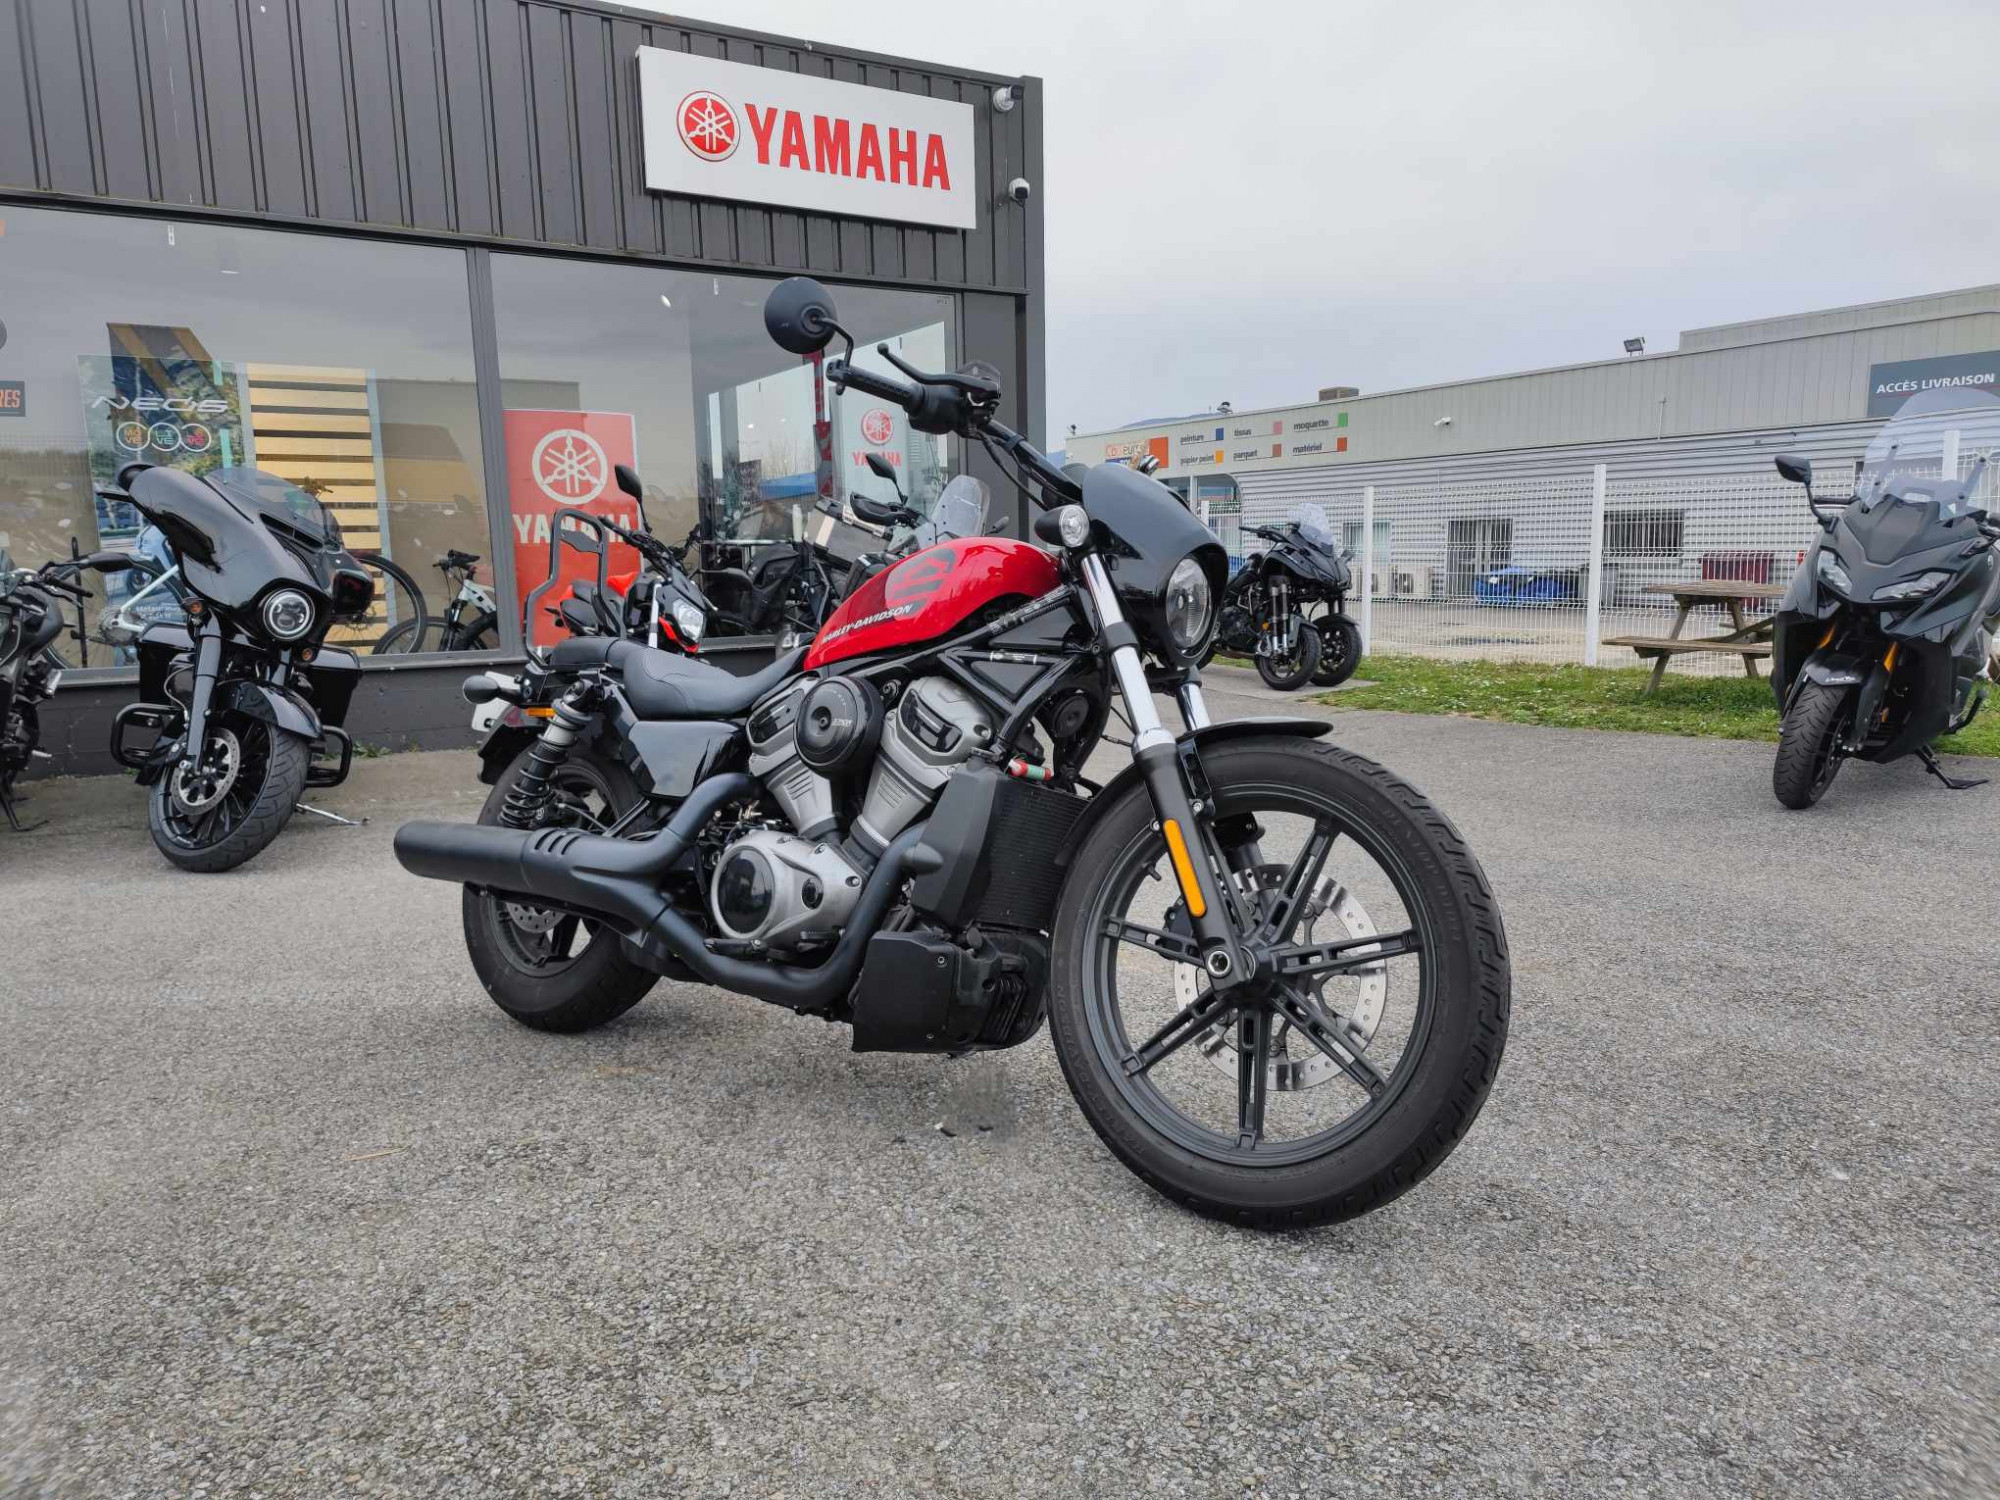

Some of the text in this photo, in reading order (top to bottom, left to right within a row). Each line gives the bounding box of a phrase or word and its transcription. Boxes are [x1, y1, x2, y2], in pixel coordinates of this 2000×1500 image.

[744, 102, 951, 191] YAMAHA
[1876, 373, 1995, 394] ACCÈS LIVRAISON
[1293, 419, 1330, 432] moquette
[1234, 427, 1252, 437] tissus
[1180, 433, 1204, 445] peinture
[1292, 442, 1322, 454] matériel
[1180, 455, 1198, 467] papier
[1233, 449, 1258, 462] parquet
